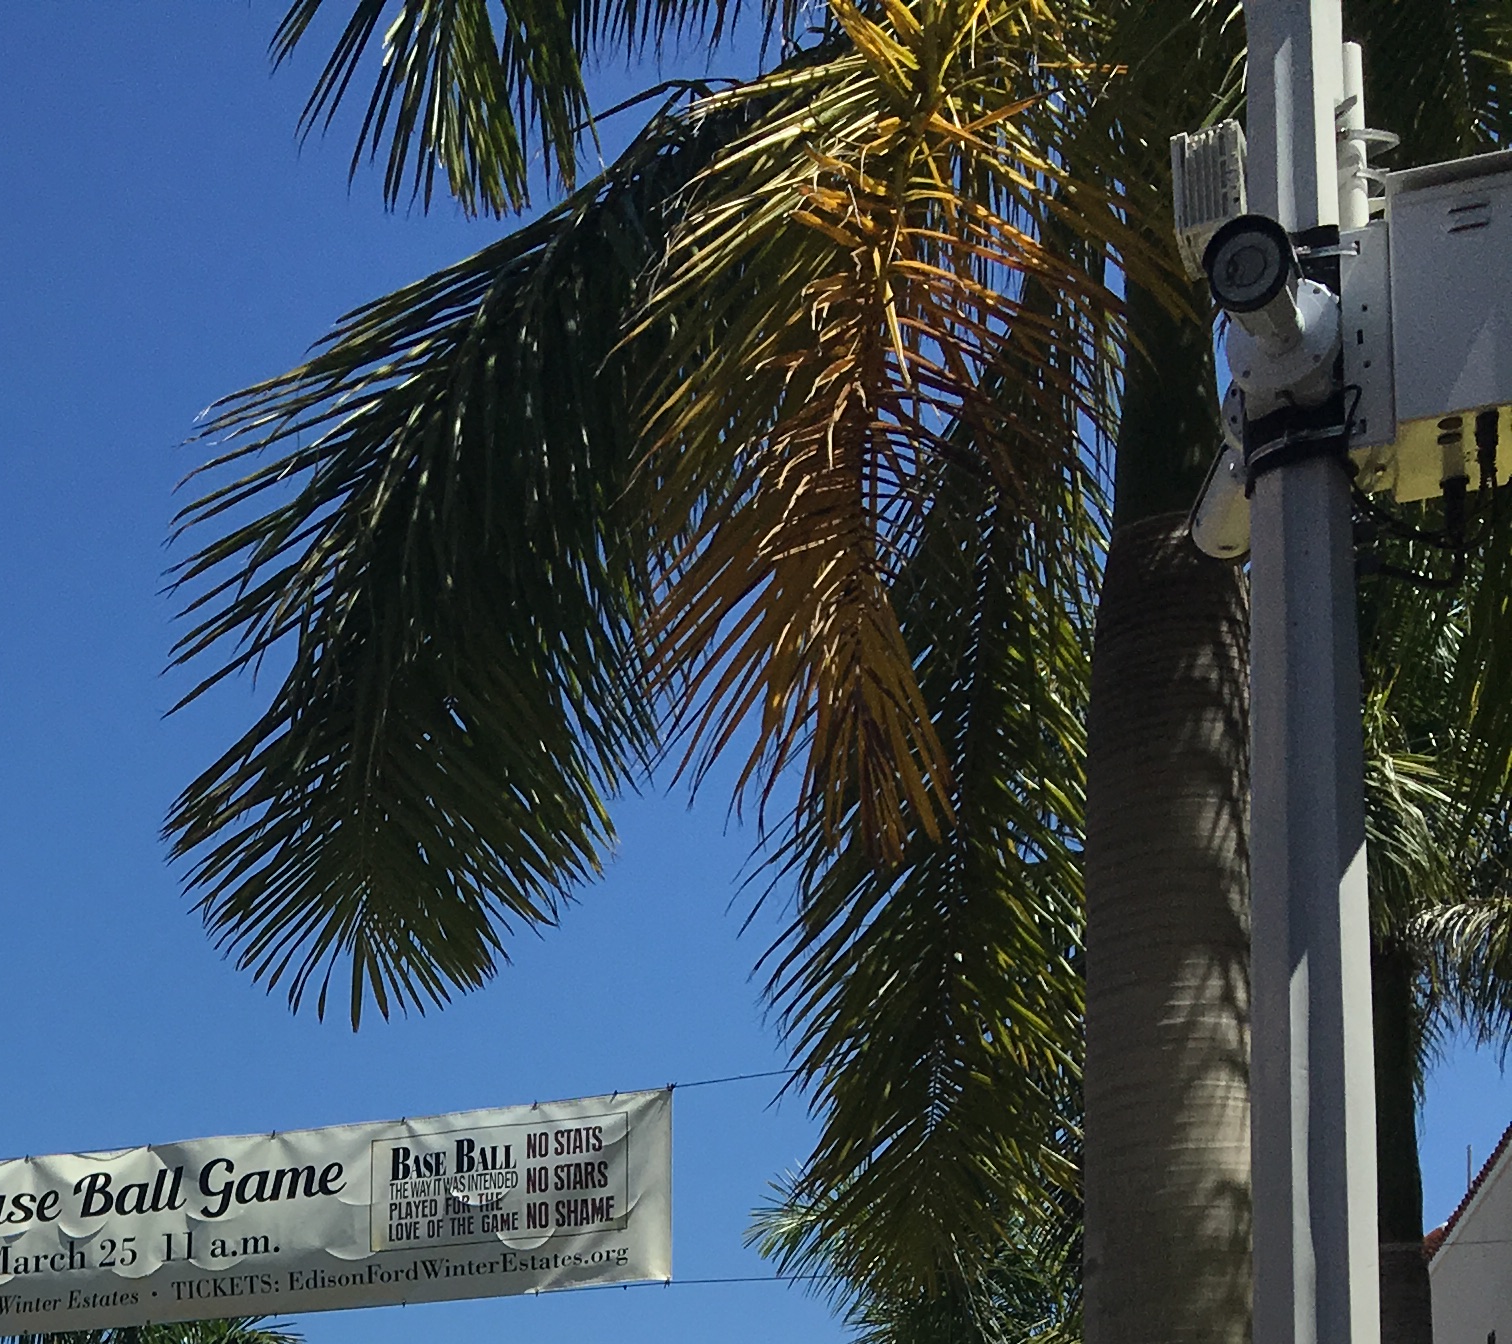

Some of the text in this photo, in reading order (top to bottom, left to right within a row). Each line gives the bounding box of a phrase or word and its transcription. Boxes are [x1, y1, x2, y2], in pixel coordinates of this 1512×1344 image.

[390, 1138, 517, 1182] BASE BALL
[526, 1125, 603, 1160] NO STATS
[73, 1165, 188, 1218] Ball
[199, 1157, 347, 1218] Game
[390, 1170, 518, 1200] THE WAY IT WAS INTENDED
[526, 1160, 608, 1194] NO STARS
[389, 1192, 502, 1221] PLAYED FOR THE
[526, 1195, 615, 1230] NO SHAME
[388, 1212, 519, 1242] LOVE OF THE GAME
[98, 1236, 137, 1268] 25
[161, 1231, 193, 1262] 11
[210, 1234, 280, 1259] a.m.
[66, 1289, 139, 1311] Estates
[172, 1274, 280, 1302] TICKETS:
[288, 1246, 629, 1292] EdisonFordWinterEstates.org
